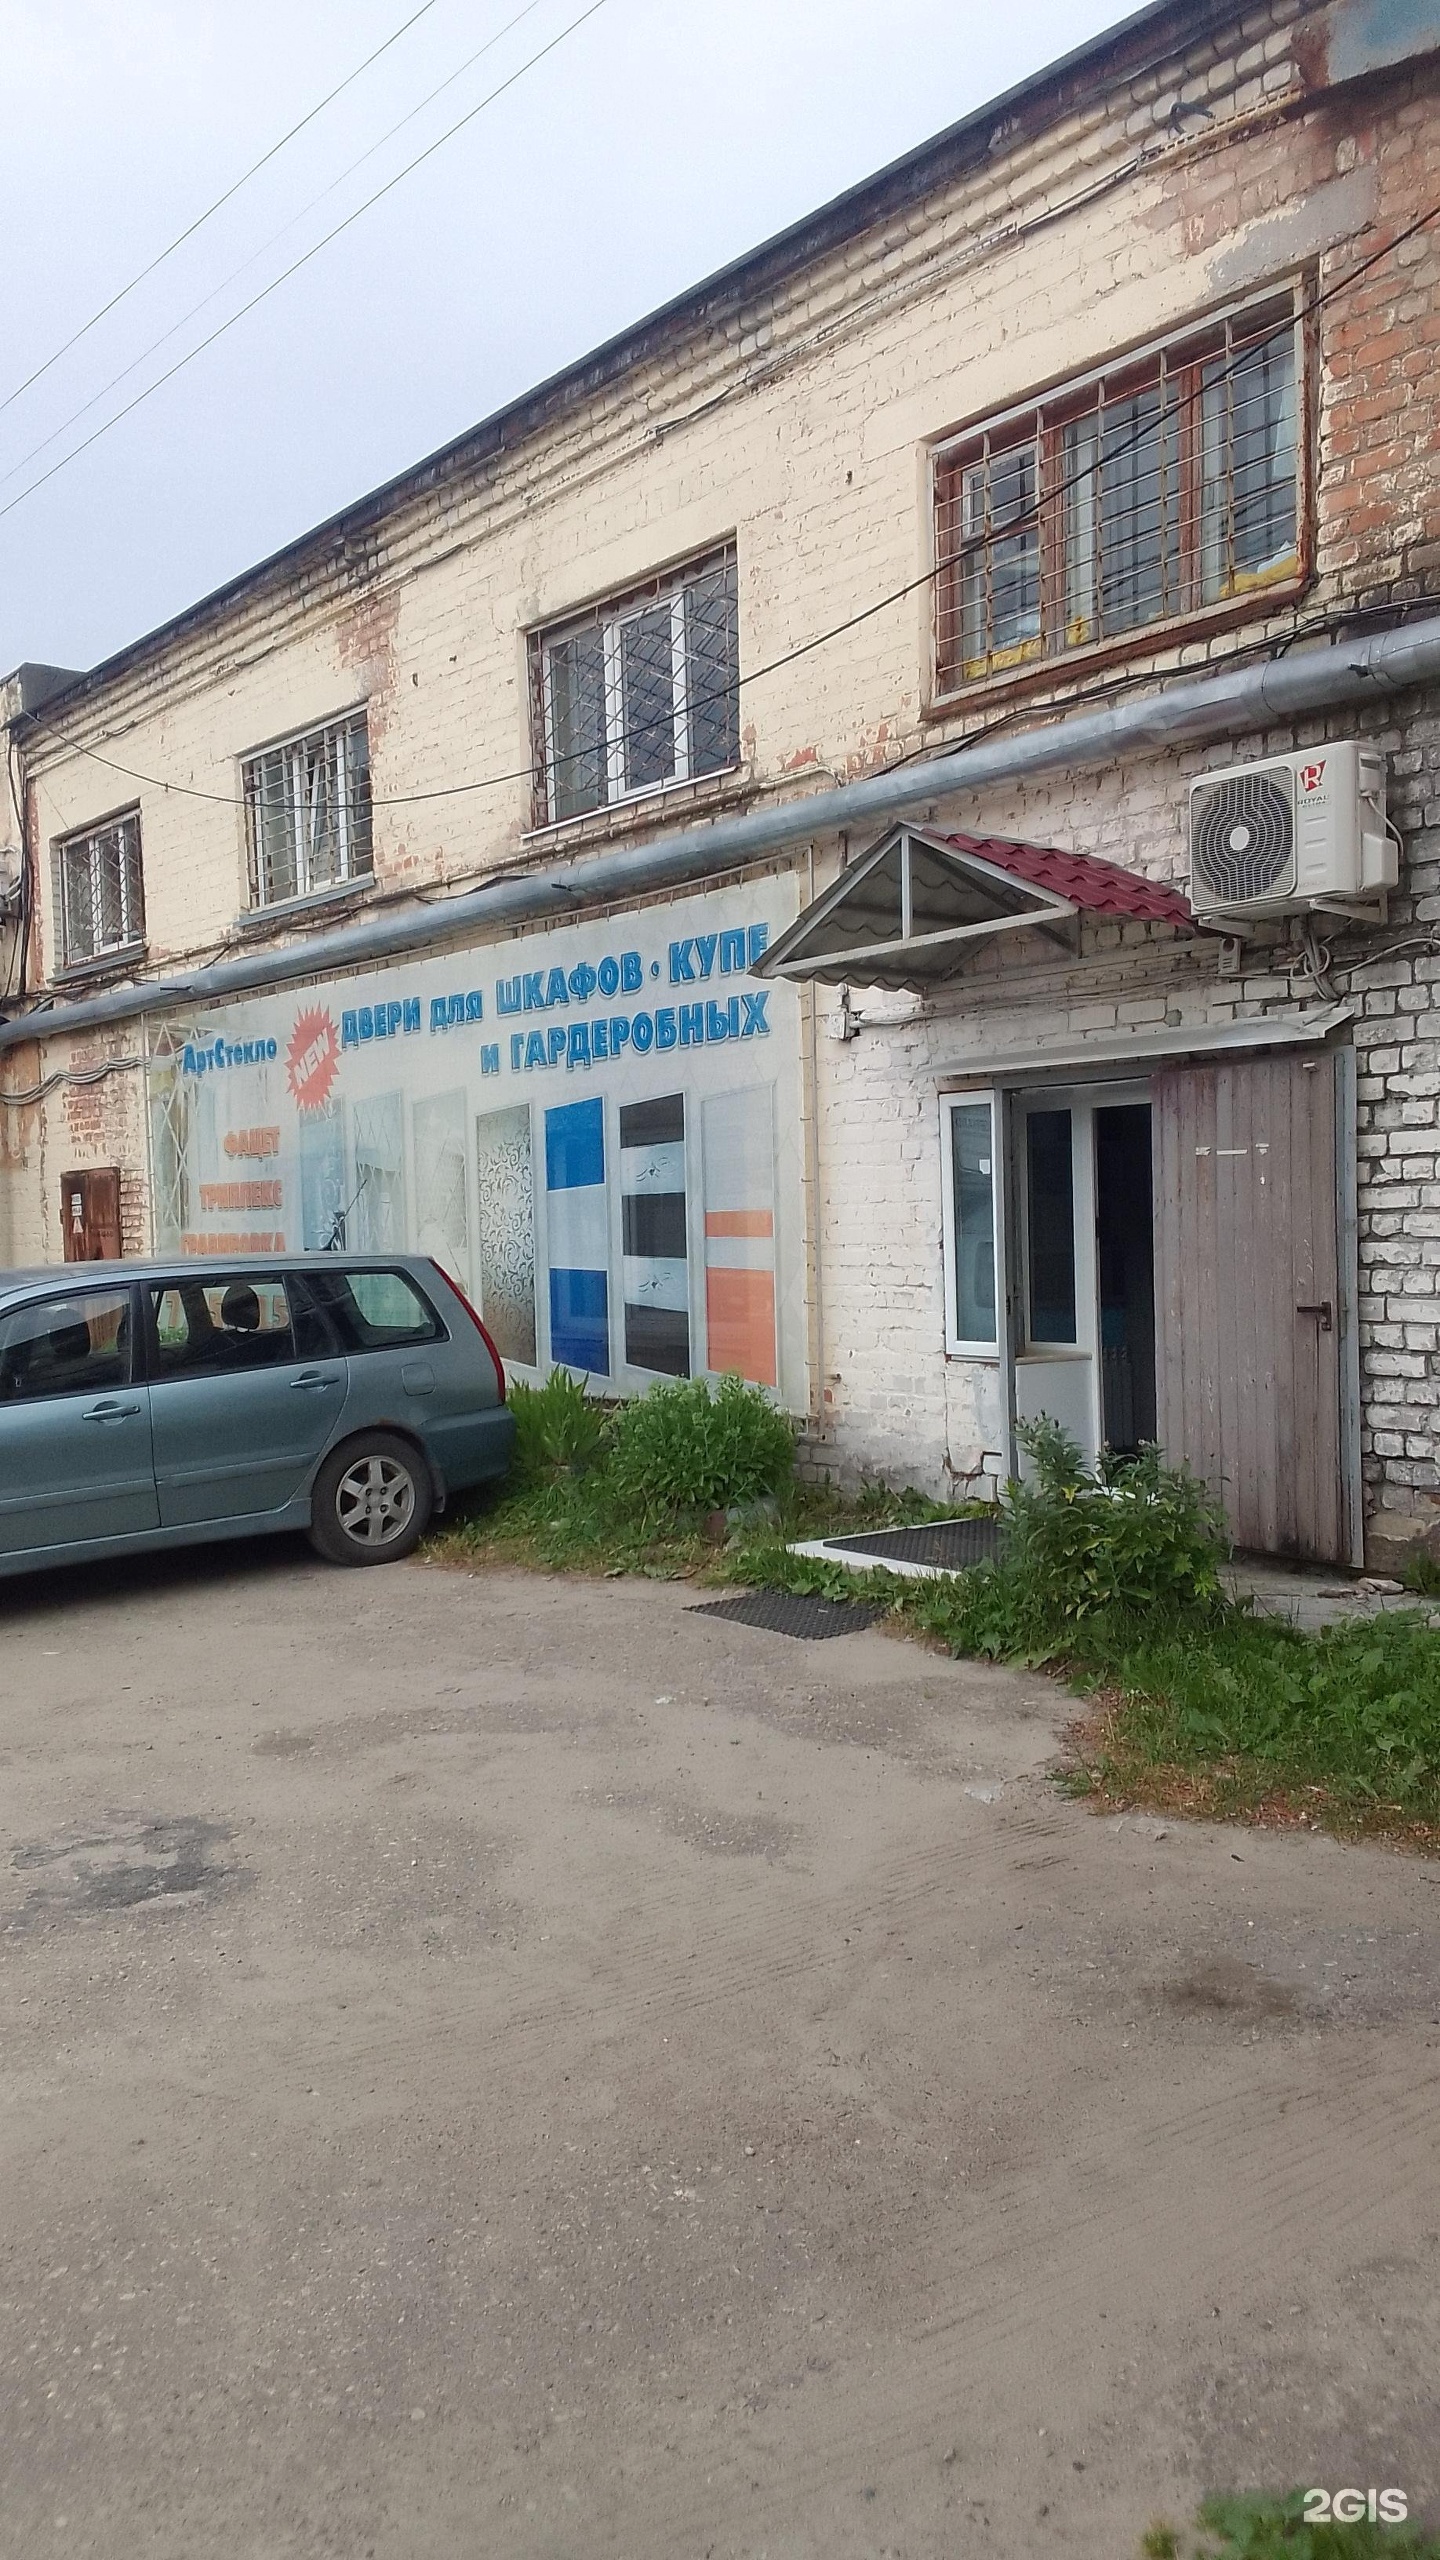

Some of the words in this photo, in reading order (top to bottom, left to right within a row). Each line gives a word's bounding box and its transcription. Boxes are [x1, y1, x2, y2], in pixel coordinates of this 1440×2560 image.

[341, 996, 421, 1049] ДВЕРИ
[429, 990, 484, 1034] ДЛЯ
[495, 951, 643, 1018] ШКАФОВ
[669, 922, 770, 984] КУПЕ
[181, 1036, 278, 1078] АртСтекло
[510, 990, 771, 1072] ГАРДЕРОБНЫХ
[293, 1026, 331, 1089] NEW
[223, 1126, 280, 1162] ФАЦЕТ
[198, 1180, 283, 1212] ТРИПЛЕКС
